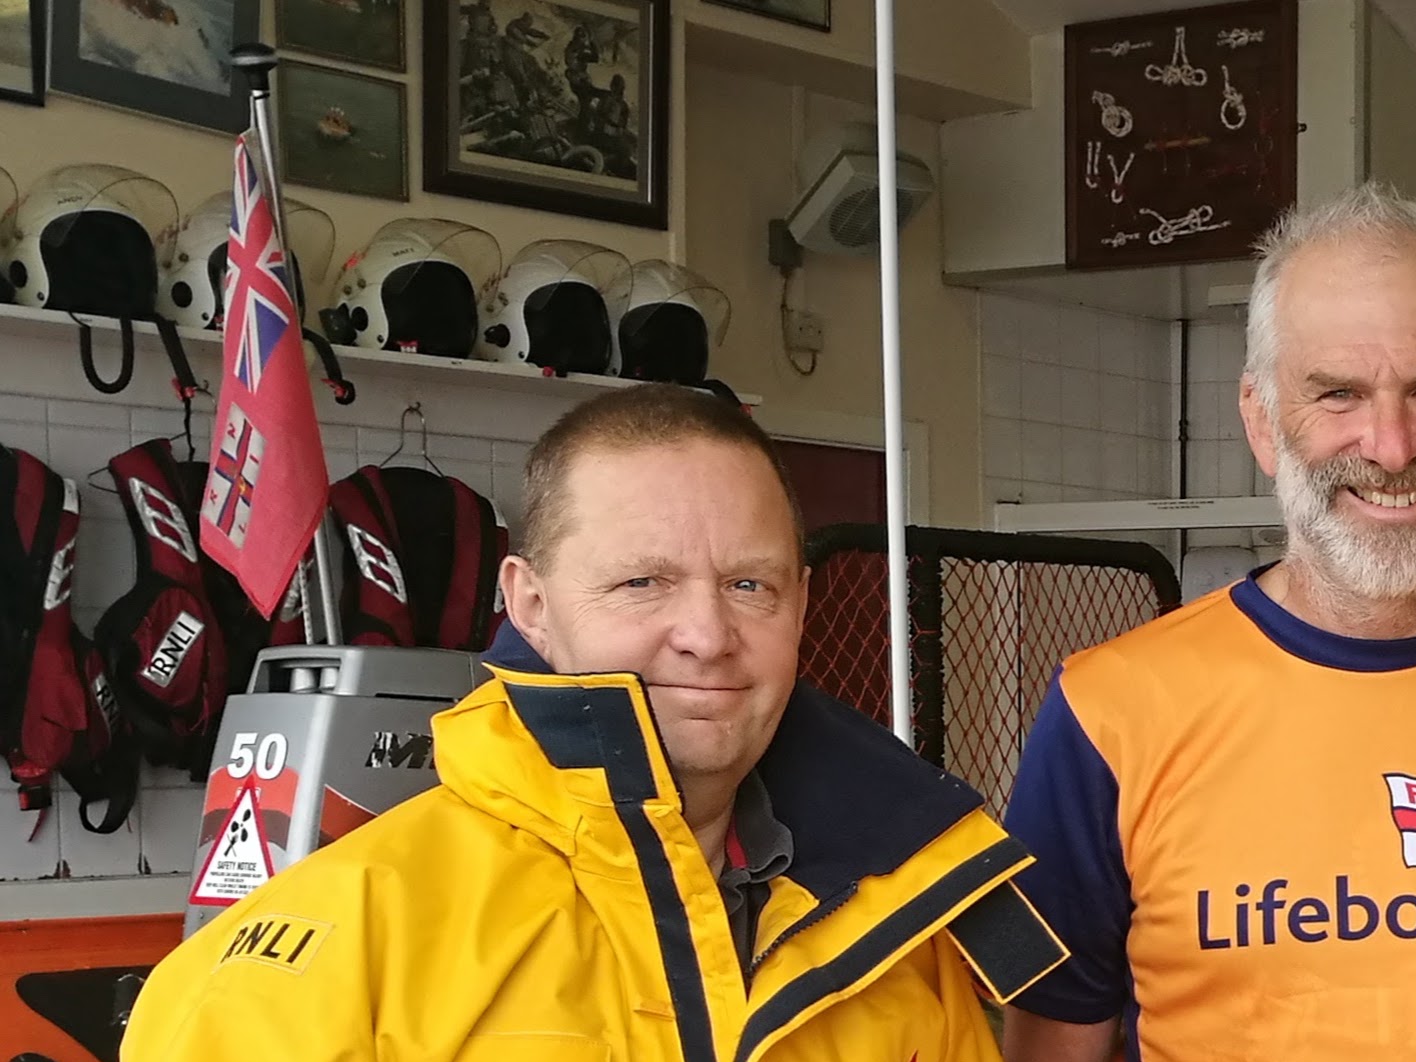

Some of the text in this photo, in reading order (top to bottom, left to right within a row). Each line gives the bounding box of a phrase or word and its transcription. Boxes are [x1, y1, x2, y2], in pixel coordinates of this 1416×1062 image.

[148, 621, 197, 677] RNLI
[227, 732, 288, 780] 50
[217, 860, 236, 870] SAFETY
[220, 920, 316, 964] RNLI
